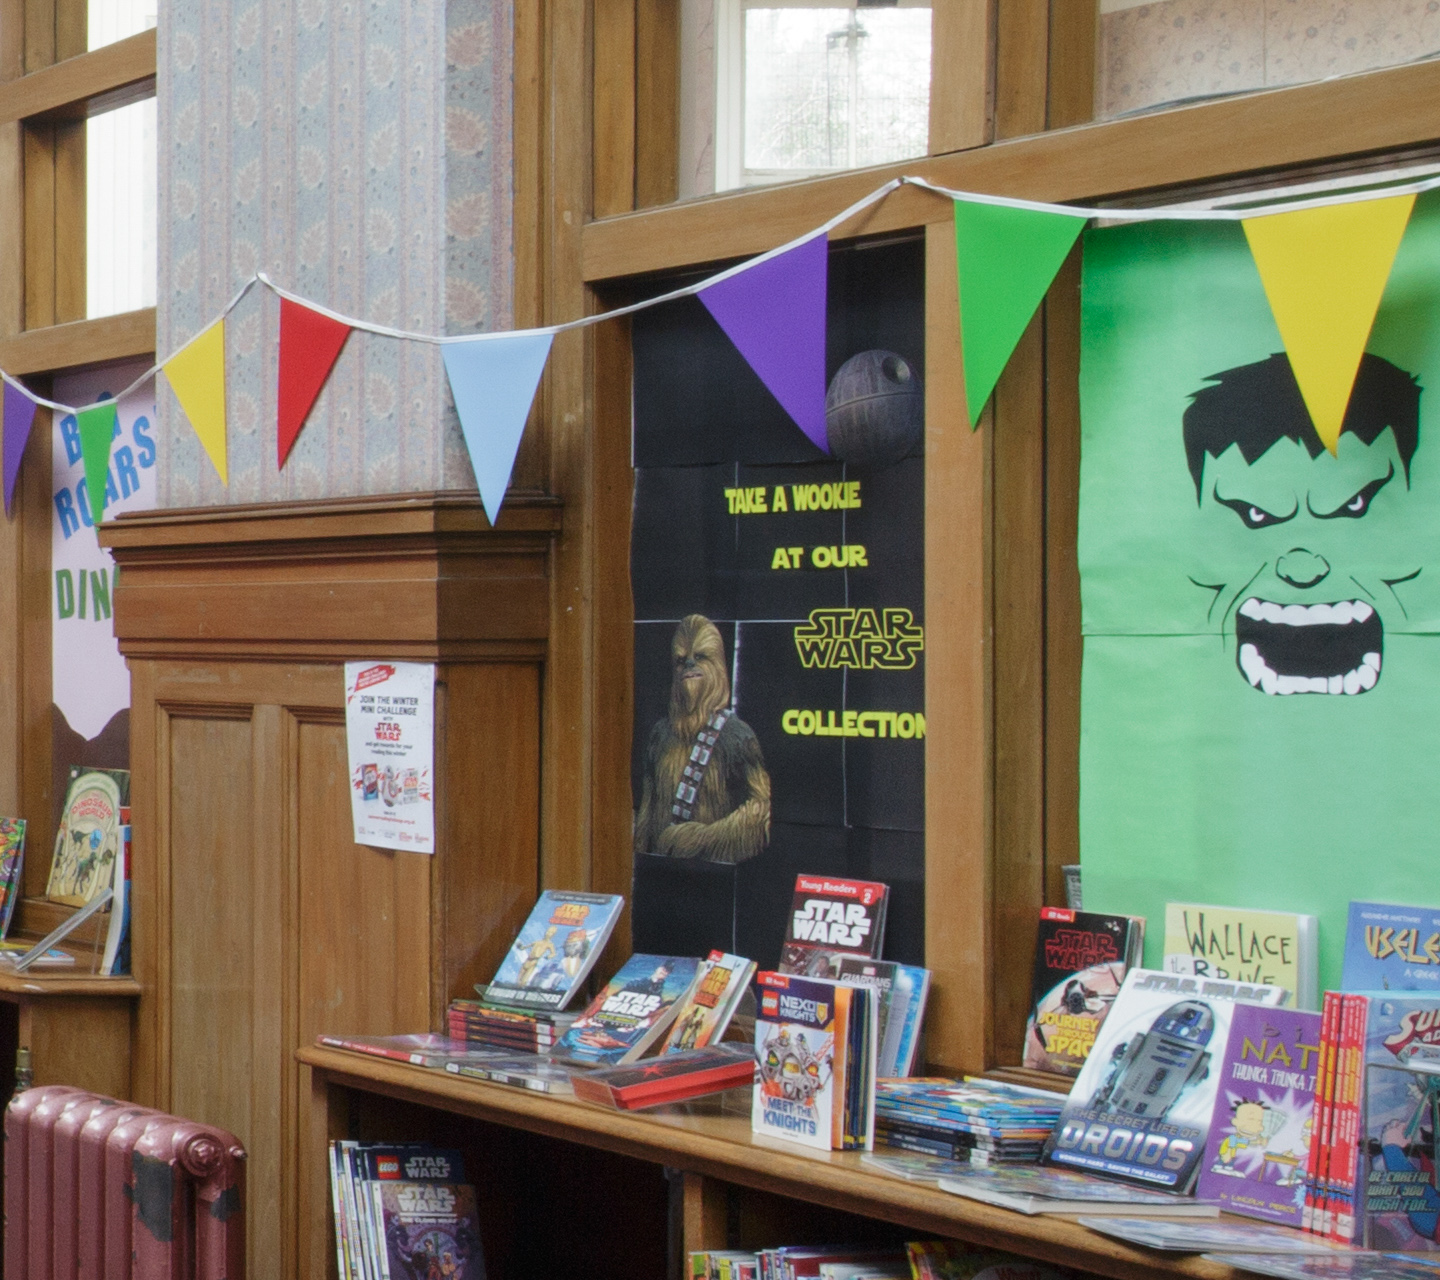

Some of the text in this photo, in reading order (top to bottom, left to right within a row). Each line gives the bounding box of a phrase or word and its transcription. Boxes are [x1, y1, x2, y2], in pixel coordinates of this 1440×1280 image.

[725, 481, 860, 514] TAKE A WOOKIE
[772, 545, 868, 569] AT OUR
[56, 566, 120, 620] DIN
[795, 608, 923, 639] STAR
[795, 637, 923, 669] WARS
[378, 696, 390, 704] THE
[393, 697, 418, 705] WINTER
[377, 707, 416, 715] CHALLENGE
[375, 723, 401, 732] STAR
[783, 710, 925, 738] COLLECTION
[375, 732, 401, 741] WARS
[72, 798, 112, 818] DINOSAUR
[79, 808, 104, 819] WORLD
[800, 880, 857, 894] Young Readers
[864, 893, 871, 903] 2
[794, 900, 871, 927] STAR
[793, 918, 869, 946] WARS
[1045, 929, 1116, 953] STAR
[1184, 911, 1291, 964] WALLACE
[1045, 948, 1118, 970] WARS
[1133, 975, 1270, 1001] STAR WARS
[602, 1000, 655, 1015] WARS
[610, 991, 662, 1008] STAR
[1039, 1014, 1098, 1032] JOURNEY
[768, 1097, 811, 1116] MEET THE
[764, 1109, 816, 1135] KNIGHTS
[1073, 1109, 1200, 1139] THE SECRET LIFE OF
[1057, 1120, 1194, 1170] DROIDS
[380, 1163, 398, 1172] LEGO
[405, 1157, 450, 1168] STAR
[406, 1168, 450, 1178] WARS
[1386, 1172, 1430, 1184] CAREFUL
[397, 1187, 455, 1200] STAR
[1368, 1185, 1424, 1197] WHAT YOU
[397, 1199, 456, 1212] WARS
